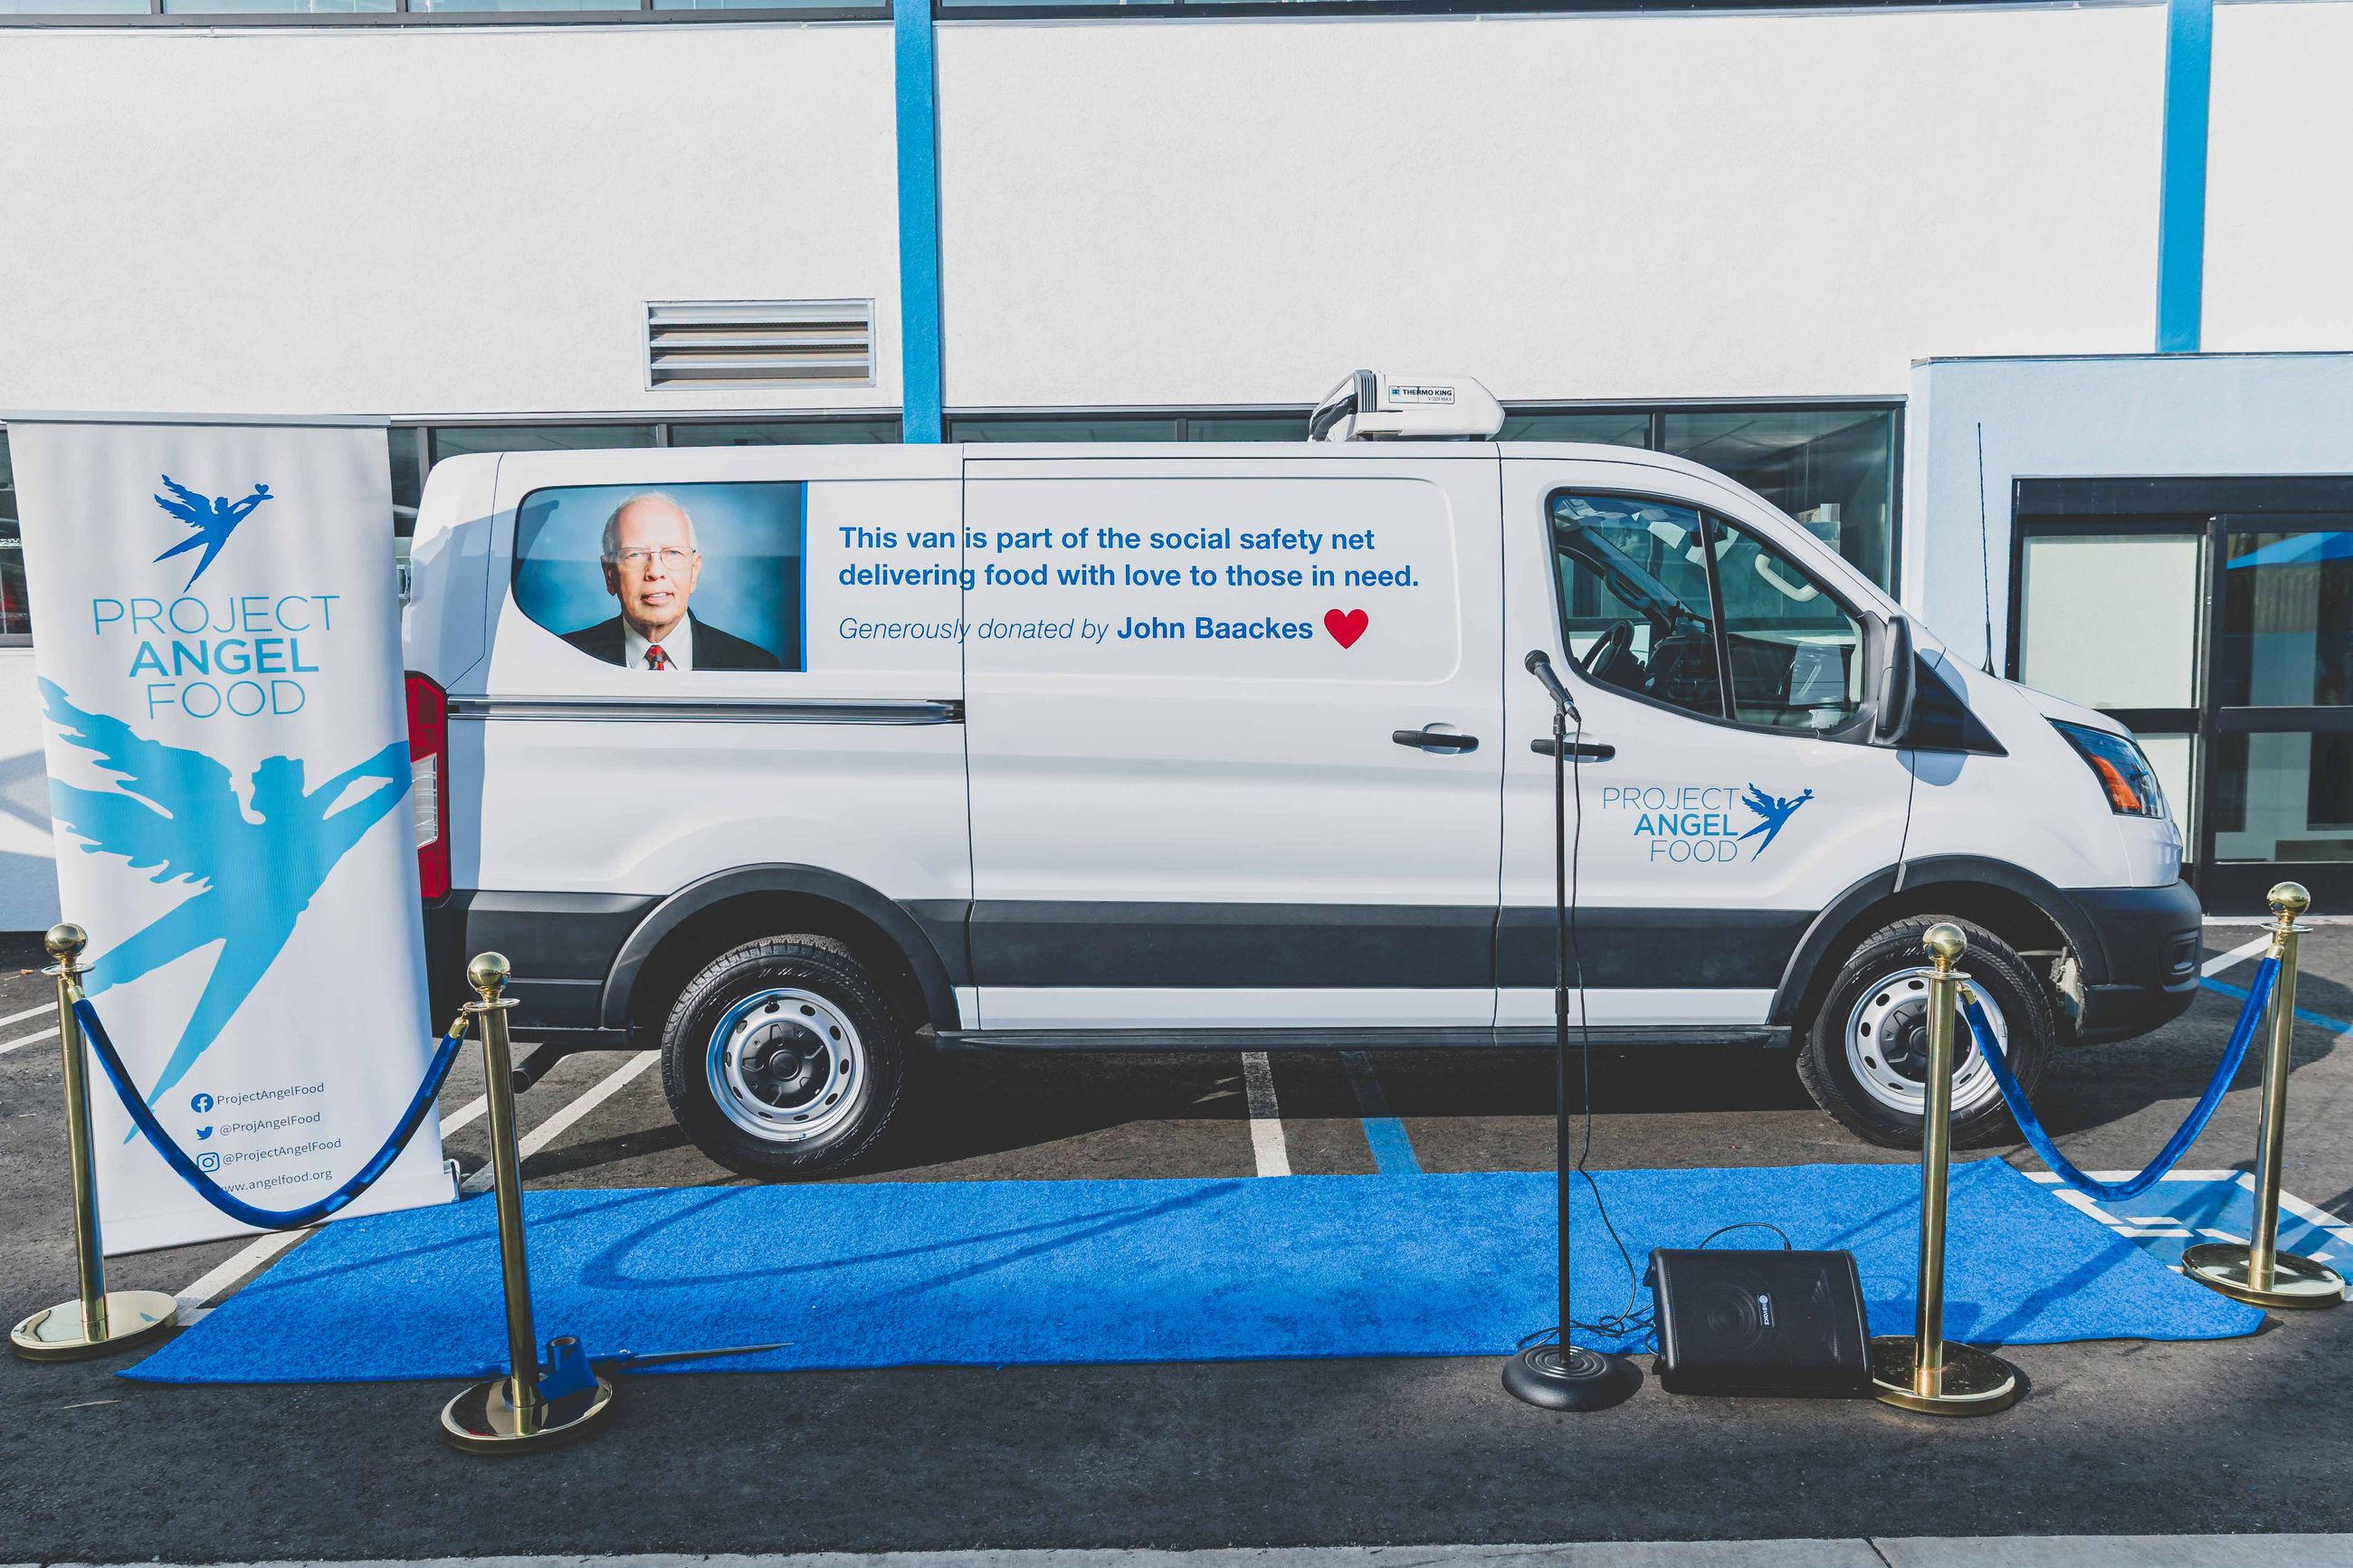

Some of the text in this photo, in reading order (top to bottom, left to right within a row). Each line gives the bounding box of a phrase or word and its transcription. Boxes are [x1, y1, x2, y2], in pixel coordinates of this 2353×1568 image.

[839, 527, 1375, 555] This van is part of the social safety net
[839, 564, 1418, 591] delivering food with love to those in need.
[92, 595, 340, 635] PROJECT
[840, 617, 1313, 644] Generously donated by John Baackes
[129, 638, 319, 678] ANGEL
[147, 680, 306, 719] FOOD
[1603, 787, 1740, 810] PROJECT
[1634, 813, 1739, 836] ANGEL
[1651, 840, 1738, 862] FOOD
[216, 1082, 325, 1105] ProjectAngelFood
[220, 1112, 321, 1136] @ProjAngelFood
[223, 1138, 341, 1165] @ProjectAngelFood
[222, 1170, 333, 1193] ww.angelfood.org
